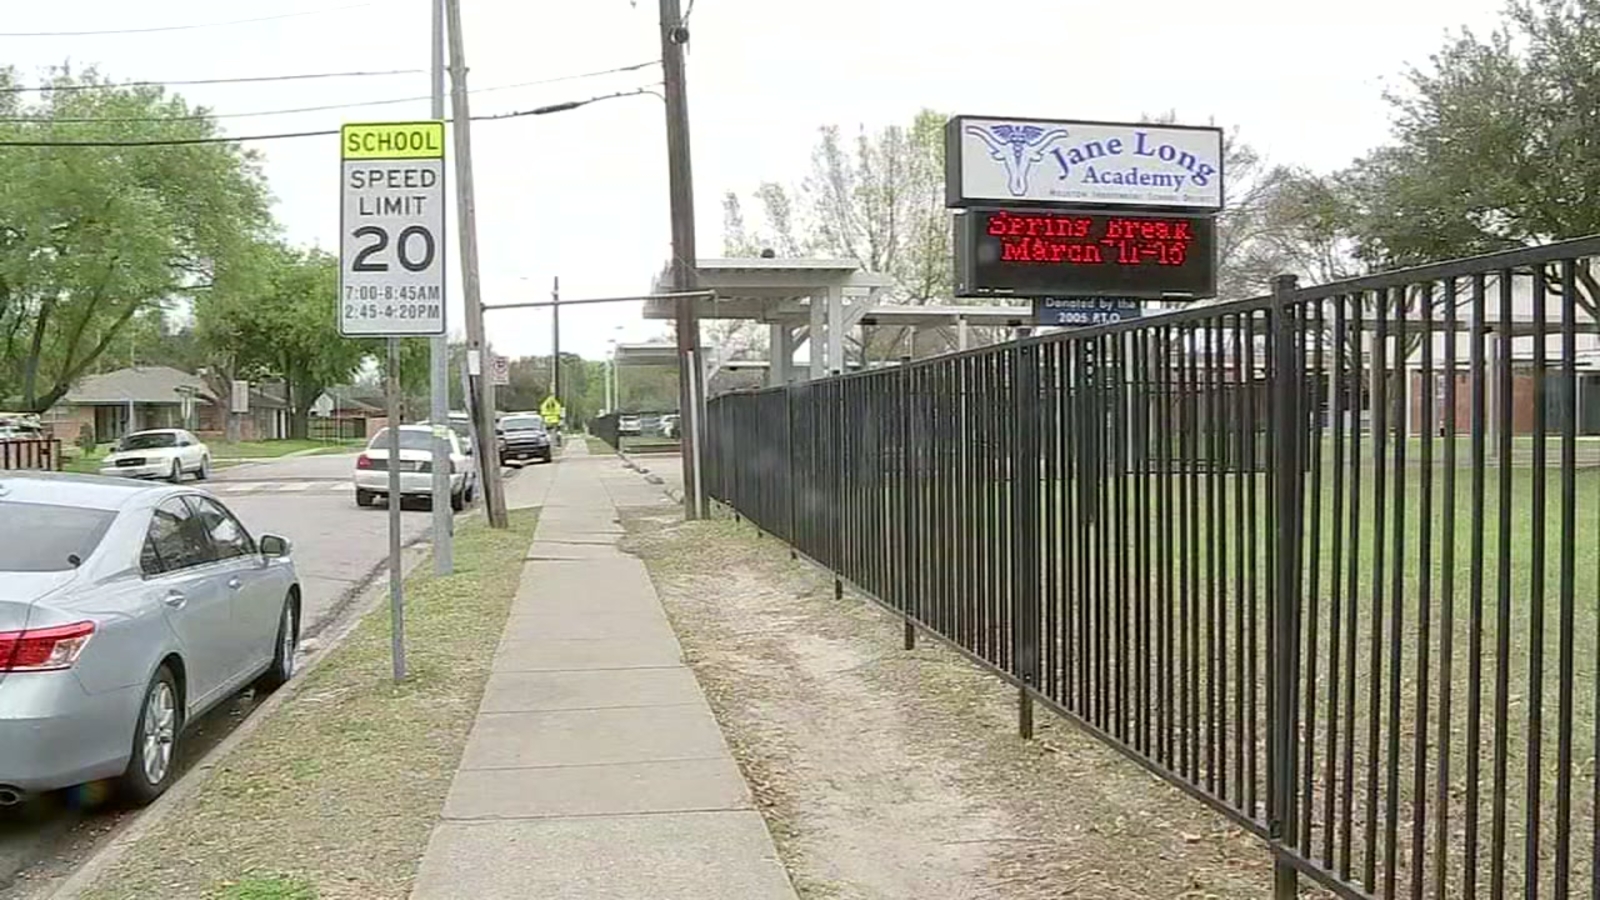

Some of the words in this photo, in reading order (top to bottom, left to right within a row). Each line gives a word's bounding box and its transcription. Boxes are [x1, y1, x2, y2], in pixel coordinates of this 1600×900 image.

[347, 131, 439, 152] SCHOOL
[1051, 137, 1123, 180] Jane
[1133, 132, 1217, 187] Long
[350, 168, 436, 189] SPEED
[1081, 167, 1186, 192] Academy
[359, 196, 427, 215] LIMIT
[988, 212, 1091, 237] Spring
[1106, 217, 1192, 240] Break
[351, 225, 436, 273] 20
[1001, 237, 1103, 262] March
[345, 285, 440, 301] 7:00-8:45AM
[345, 304, 440, 320] 2:45-4:20PM
[1045, 297, 1095, 309] Donated
[1099, 298, 1113, 311] by
[1118, 299, 1136, 309] the
[1058, 312, 1088, 323] 2005
